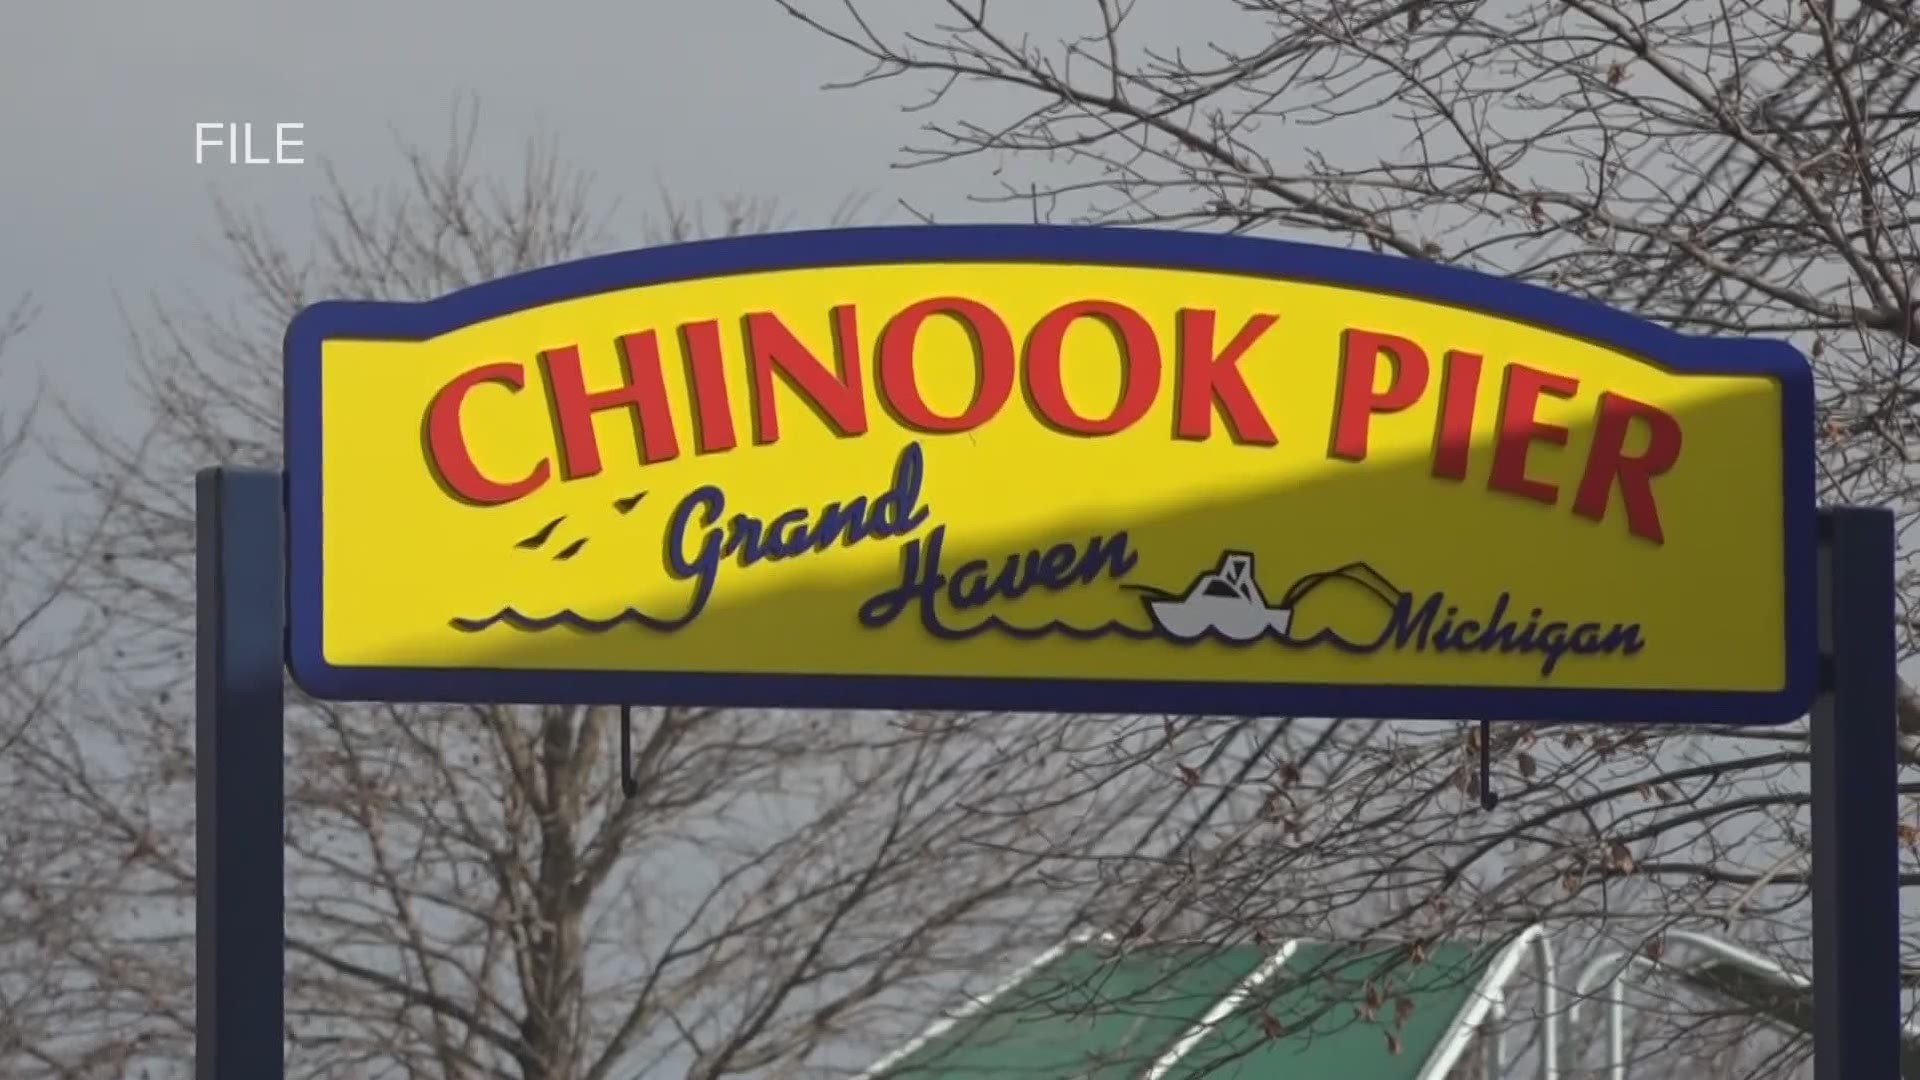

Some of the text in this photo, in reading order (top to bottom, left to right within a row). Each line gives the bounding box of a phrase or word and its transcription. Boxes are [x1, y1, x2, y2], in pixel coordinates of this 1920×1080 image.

[420, 295, 1683, 545] CHINOOK PIER
[662, 441, 929, 592] Grand
[857, 523, 1139, 632] Haven
[1392, 590, 1644, 676] Michigan
